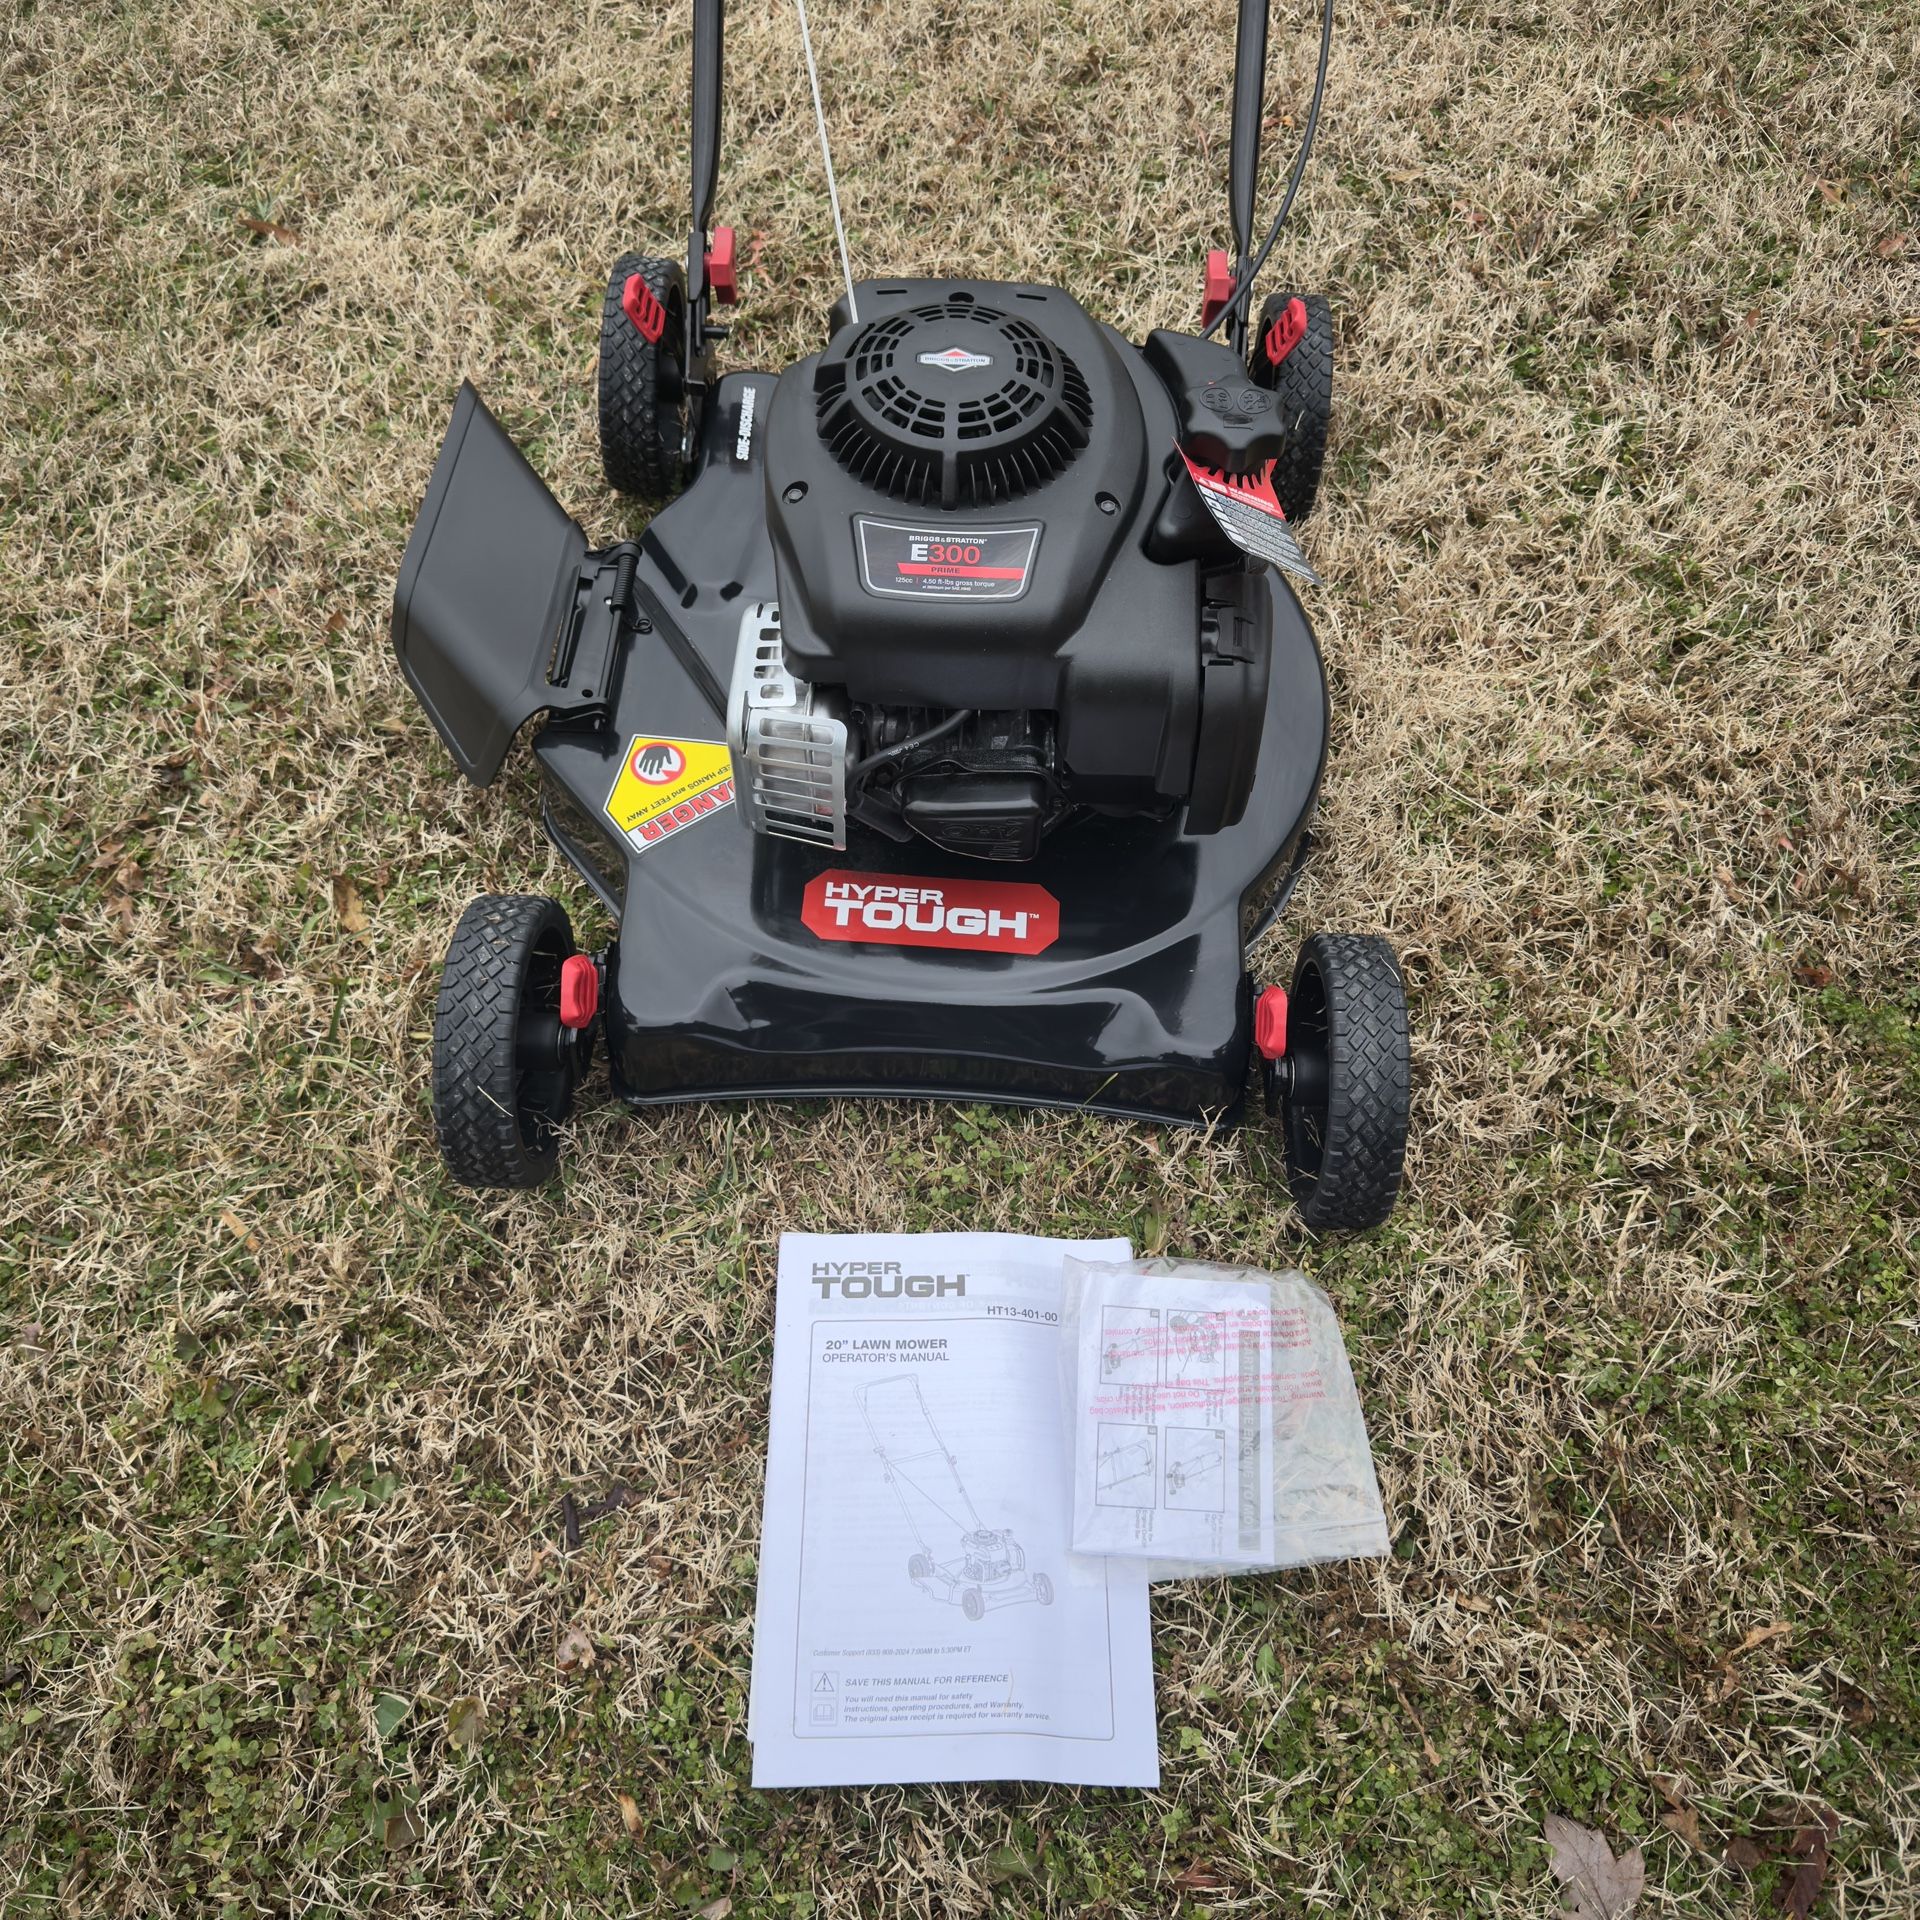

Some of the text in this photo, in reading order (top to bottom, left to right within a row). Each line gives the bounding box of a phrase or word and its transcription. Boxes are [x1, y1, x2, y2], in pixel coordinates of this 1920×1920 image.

[736, 386, 756, 461] SIDE-DISCHARGE
[911, 543, 981, 565] E300
[895, 576, 913, 584] 125cc
[922, 577, 938, 585] 4.50
[955, 580, 972, 588] gross
[626, 763, 731, 823] EEP HANDS and FEET AWAY
[826, 881, 945, 906] HYPER
[824, 898, 1028, 939] TOUGH
[812, 1262, 902, 1275] HYPER
[812, 1274, 966, 1299] TOUGH
[987, 1305, 1058, 1322] HT13-401-00
[852, 1339, 891, 1350] LAWN
[895, 1338, 948, 1349] MOWER
[822, 1352, 950, 1363] OPERATOR'S MANUAL
[1192, 1378, 1209, 1387] This
[1173, 1391, 1186, 1400] not
[1243, 1429, 1255, 1478] ENGINE
[1243, 1482, 1255, 1500] TO
[813, 1648, 841, 1657] Customer
[842, 1648, 865, 1658] Support
[934, 1647, 941, 1655] to
[845, 1674, 1009, 1687] SAVE THIS MANUAL FOR REFERENCE
[845, 1695, 859, 1703] You
[861, 1695, 875, 1703] will
[875, 1695, 894, 1703] need
[910, 1693, 938, 1701] manual
[939, 1693, 950, 1701] for
[951, 1692, 974, 1701] safety
[891, 1704, 927, 1713] operating
[928, 1702, 972, 1712] procedures,
[973, 1701, 988, 1709] and
[845, 1711, 1052, 1723] The original sales receipt is required for warranty service.
